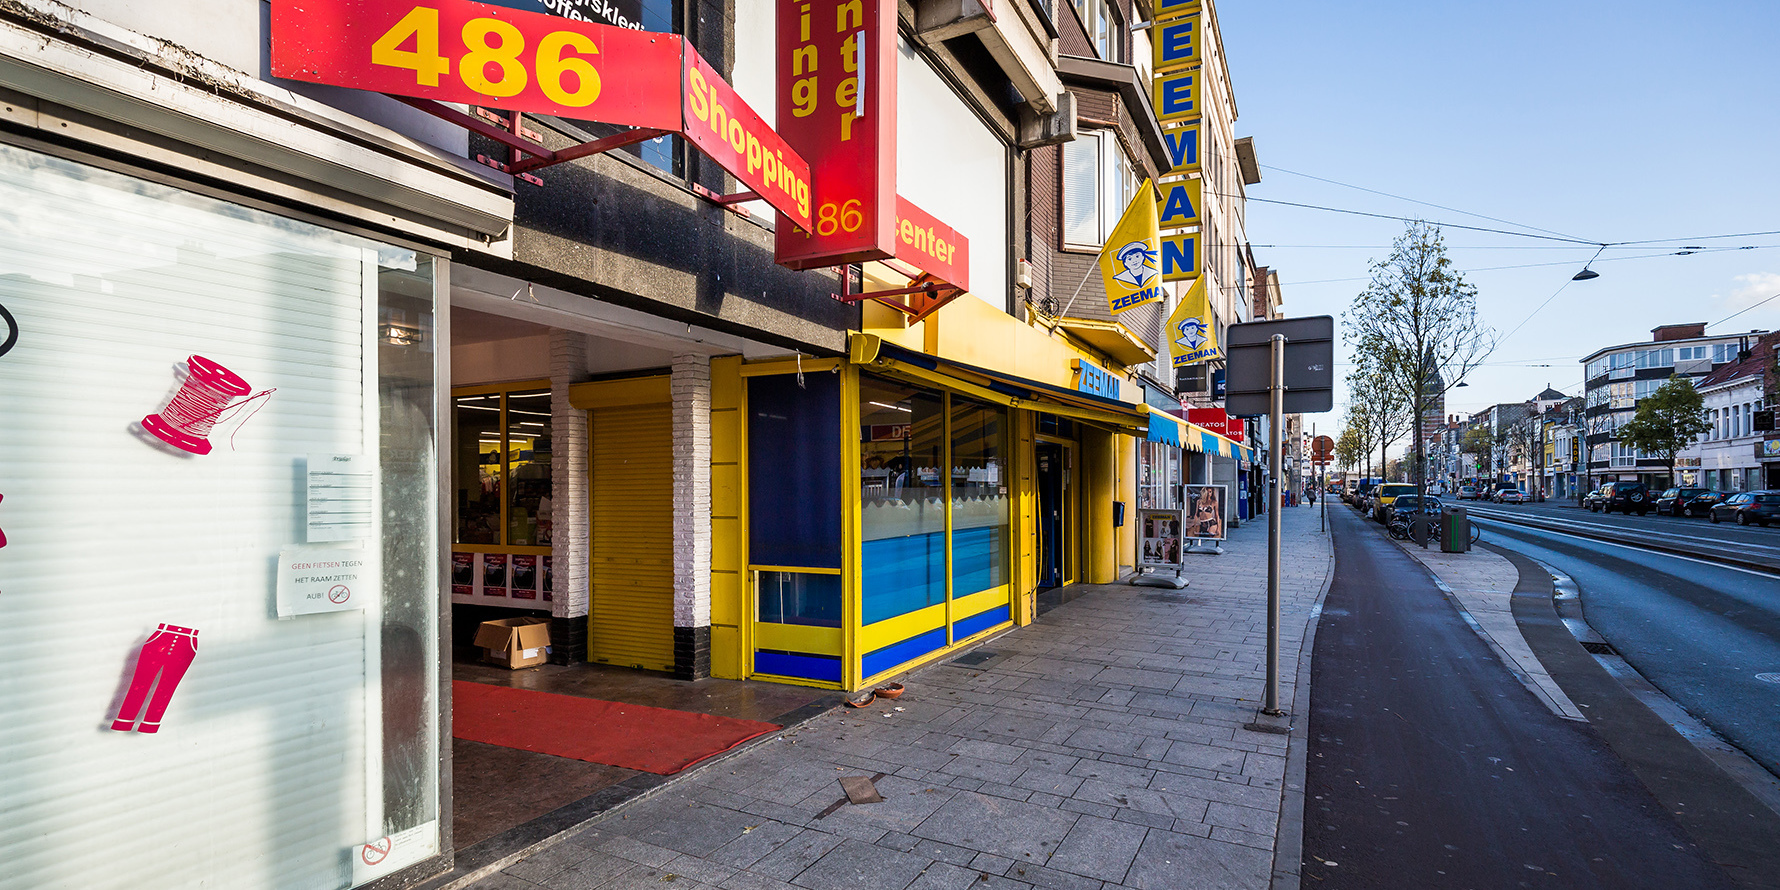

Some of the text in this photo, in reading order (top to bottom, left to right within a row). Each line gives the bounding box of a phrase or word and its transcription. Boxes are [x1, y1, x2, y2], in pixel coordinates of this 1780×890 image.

[371, 5, 602, 108] 486
[791, 0, 819, 118] ing
[689, 66, 811, 219] Shopping
[1160, 0, 1197, 275] EEMAN
[1111, 286, 1164, 312] ZEEMA
[1173, 347, 1218, 365] ZEEMAN
[1079, 358, 1120, 400] ZEEMAN
[1192, 421, 1226, 429] REATOS
[312, 561, 340, 569] FIETSEN
[341, 560, 363, 568] TEGEN
[294, 574, 358, 584] HET RAAM ZETTEN
[306, 592, 325, 600] AUB!
